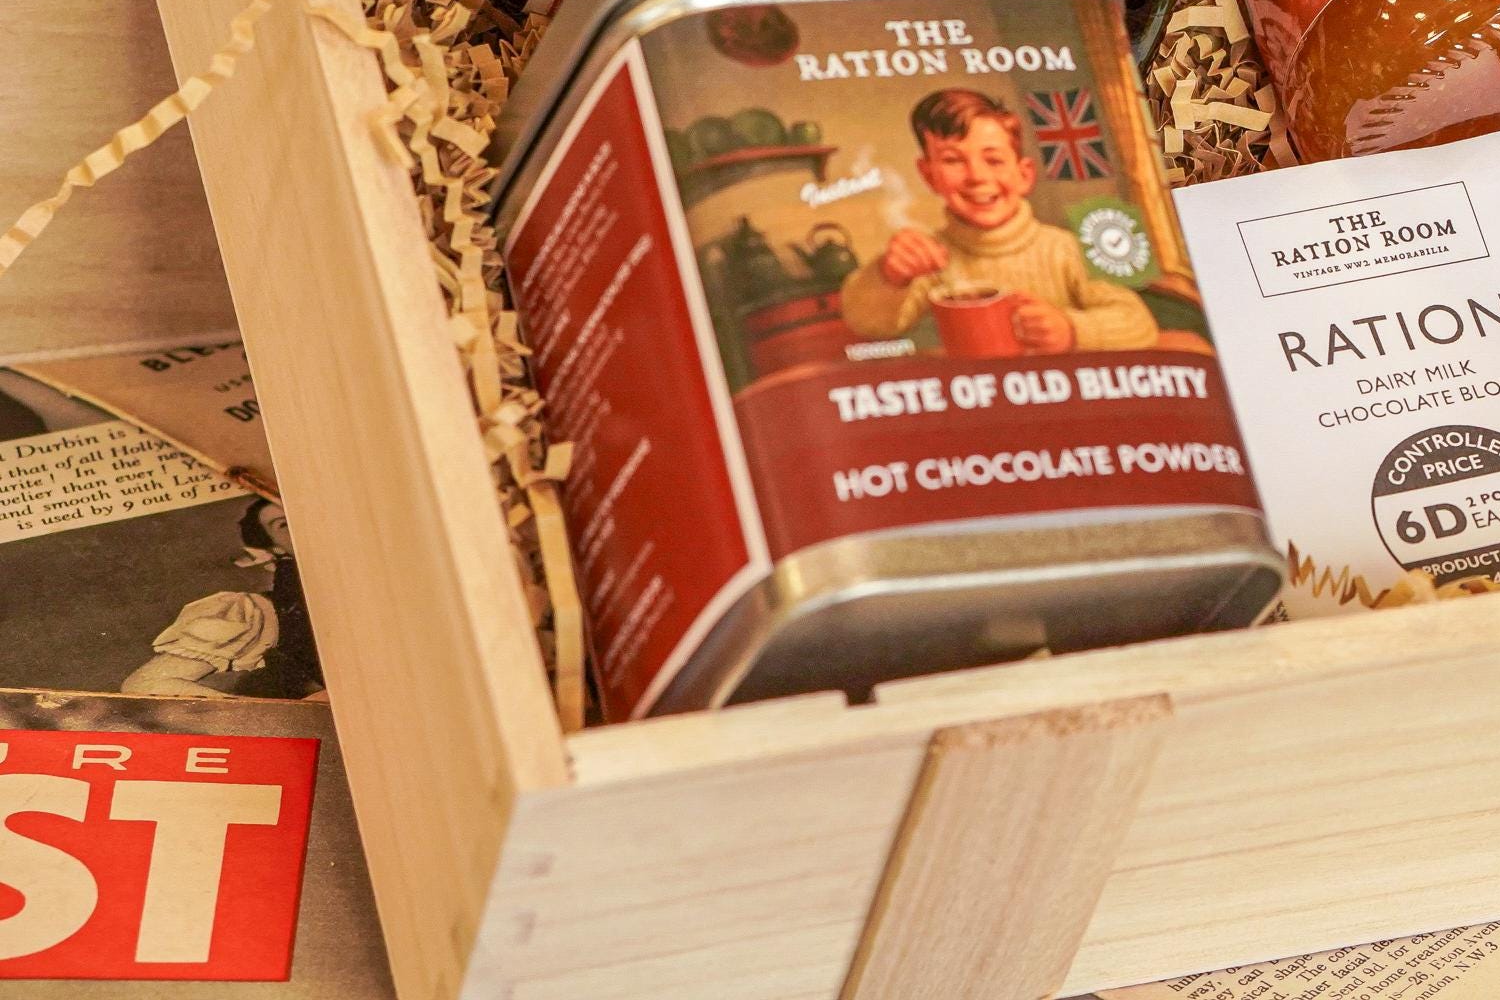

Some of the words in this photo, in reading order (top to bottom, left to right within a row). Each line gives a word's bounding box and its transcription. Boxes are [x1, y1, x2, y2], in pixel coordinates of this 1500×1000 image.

[884, 18, 975, 48] THE
[794, 48, 949, 82] RATION
[960, 44, 1078, 75] ROOM
[1328, 210, 1387, 235] THE
[1271, 234, 1372, 268] RATION
[1379, 218, 1458, 248] ROOM
[1292, 264, 1341, 280] VINTAGE
[1344, 258, 1371, 271] WW2
[1374, 244, 1450, 266] MEMORABILIA
[828, 376, 948, 423] TASTE
[949, 372, 999, 410] OF
[1001, 368, 1073, 407] OLD
[1074, 363, 1210, 402] BLIGHTY
[1355, 369, 1417, 395] DAIRY
[1424, 359, 1477, 383] MILK
[1317, 389, 1455, 428] CHOCOLATE
[16, 430, 99, 459] Durbin
[832, 459, 911, 502] HOT
[914, 444, 1116, 491] CHOCOLATE
[1116, 441, 1246, 476] POWDER
[1422, 453, 1484, 480] PRICE
[1465, 496, 1477, 508] 2
[1395, 502, 1468, 545] 6D
